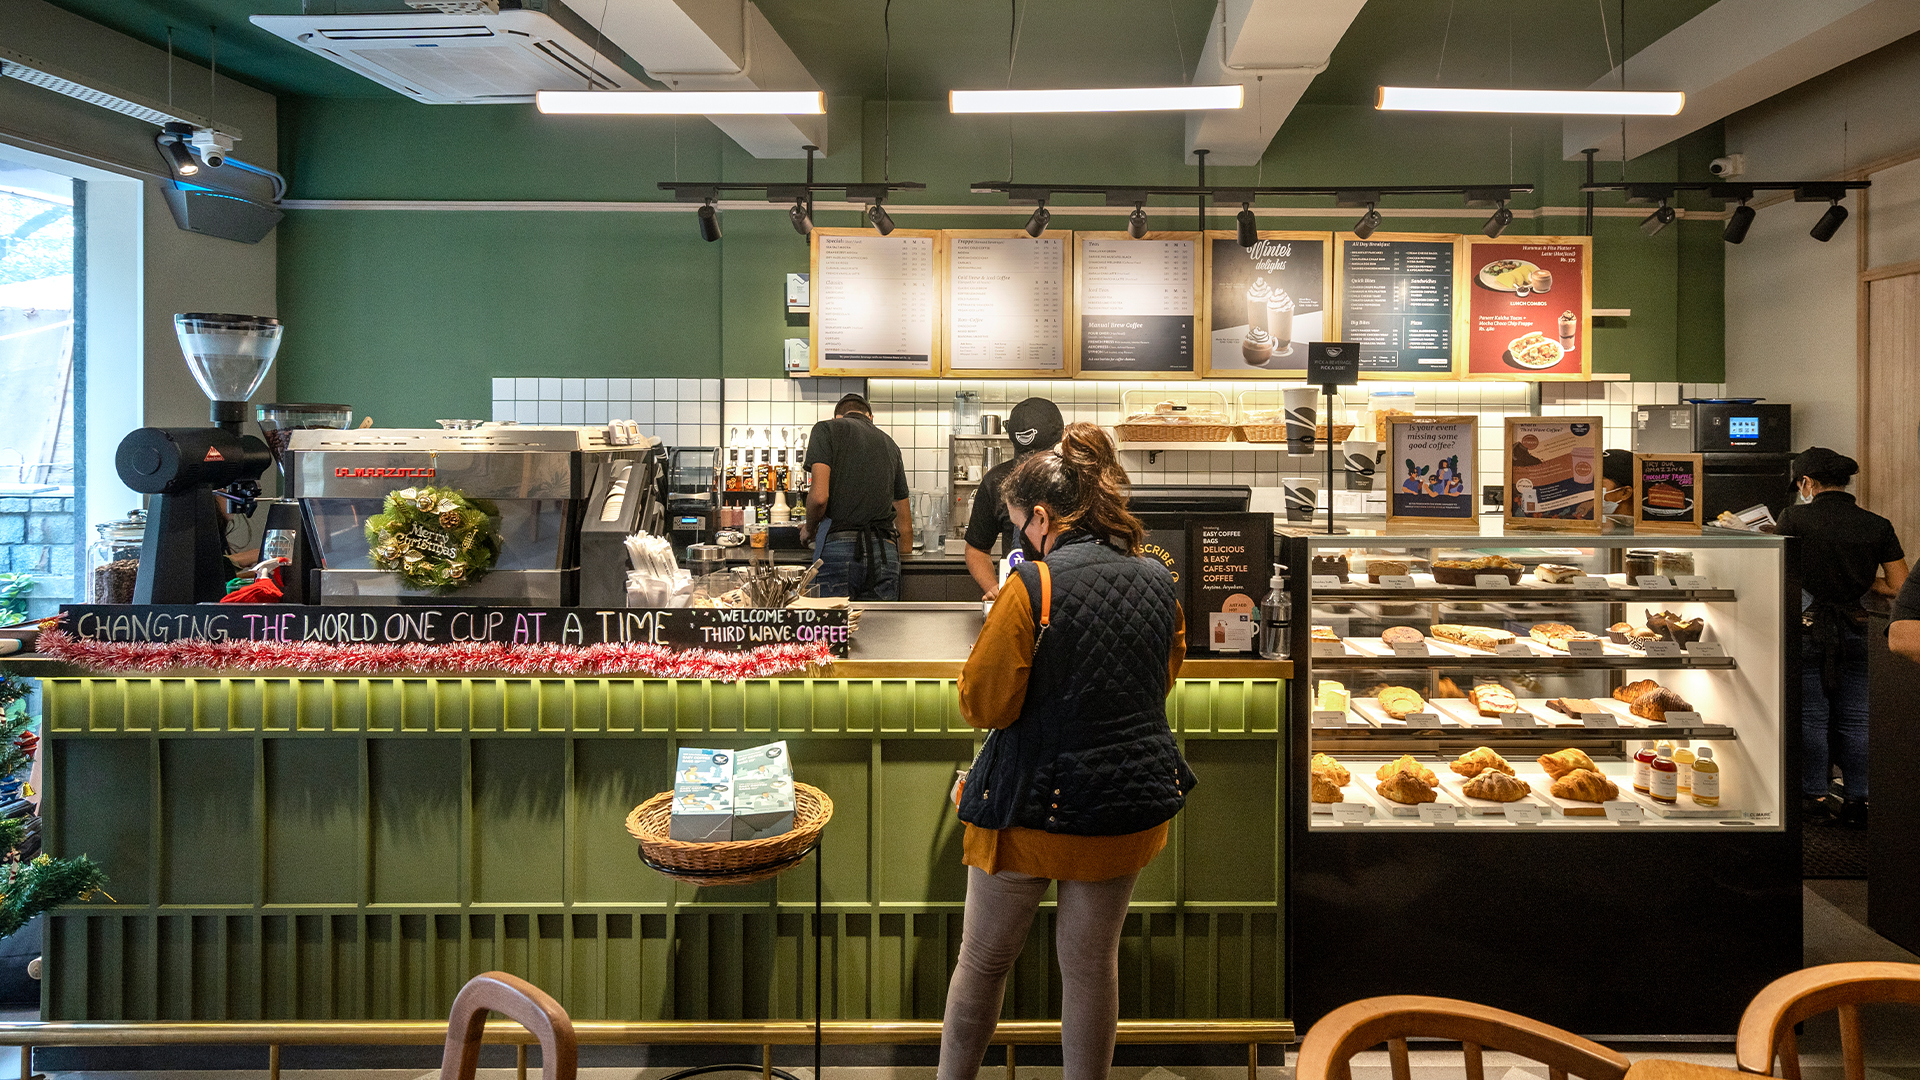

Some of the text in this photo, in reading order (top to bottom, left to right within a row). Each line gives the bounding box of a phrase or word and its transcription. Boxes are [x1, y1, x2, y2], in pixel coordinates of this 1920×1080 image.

[1246, 239, 1292, 260] Winter
[1256, 259, 1287, 274] delights
[1408, 441, 1456, 450] good coffee?
[411, 521, 449, 544] Merry
[395, 533, 456, 559] Christmas
[1139, 544, 1175, 567] SCRIBE
[718, 609, 816, 623] WELCOME TO
[78, 611, 673, 645] CHANGING THE WORLD ONE CUP AT A TIME
[700, 625, 848, 643] THIRD WAVE COFFEE
